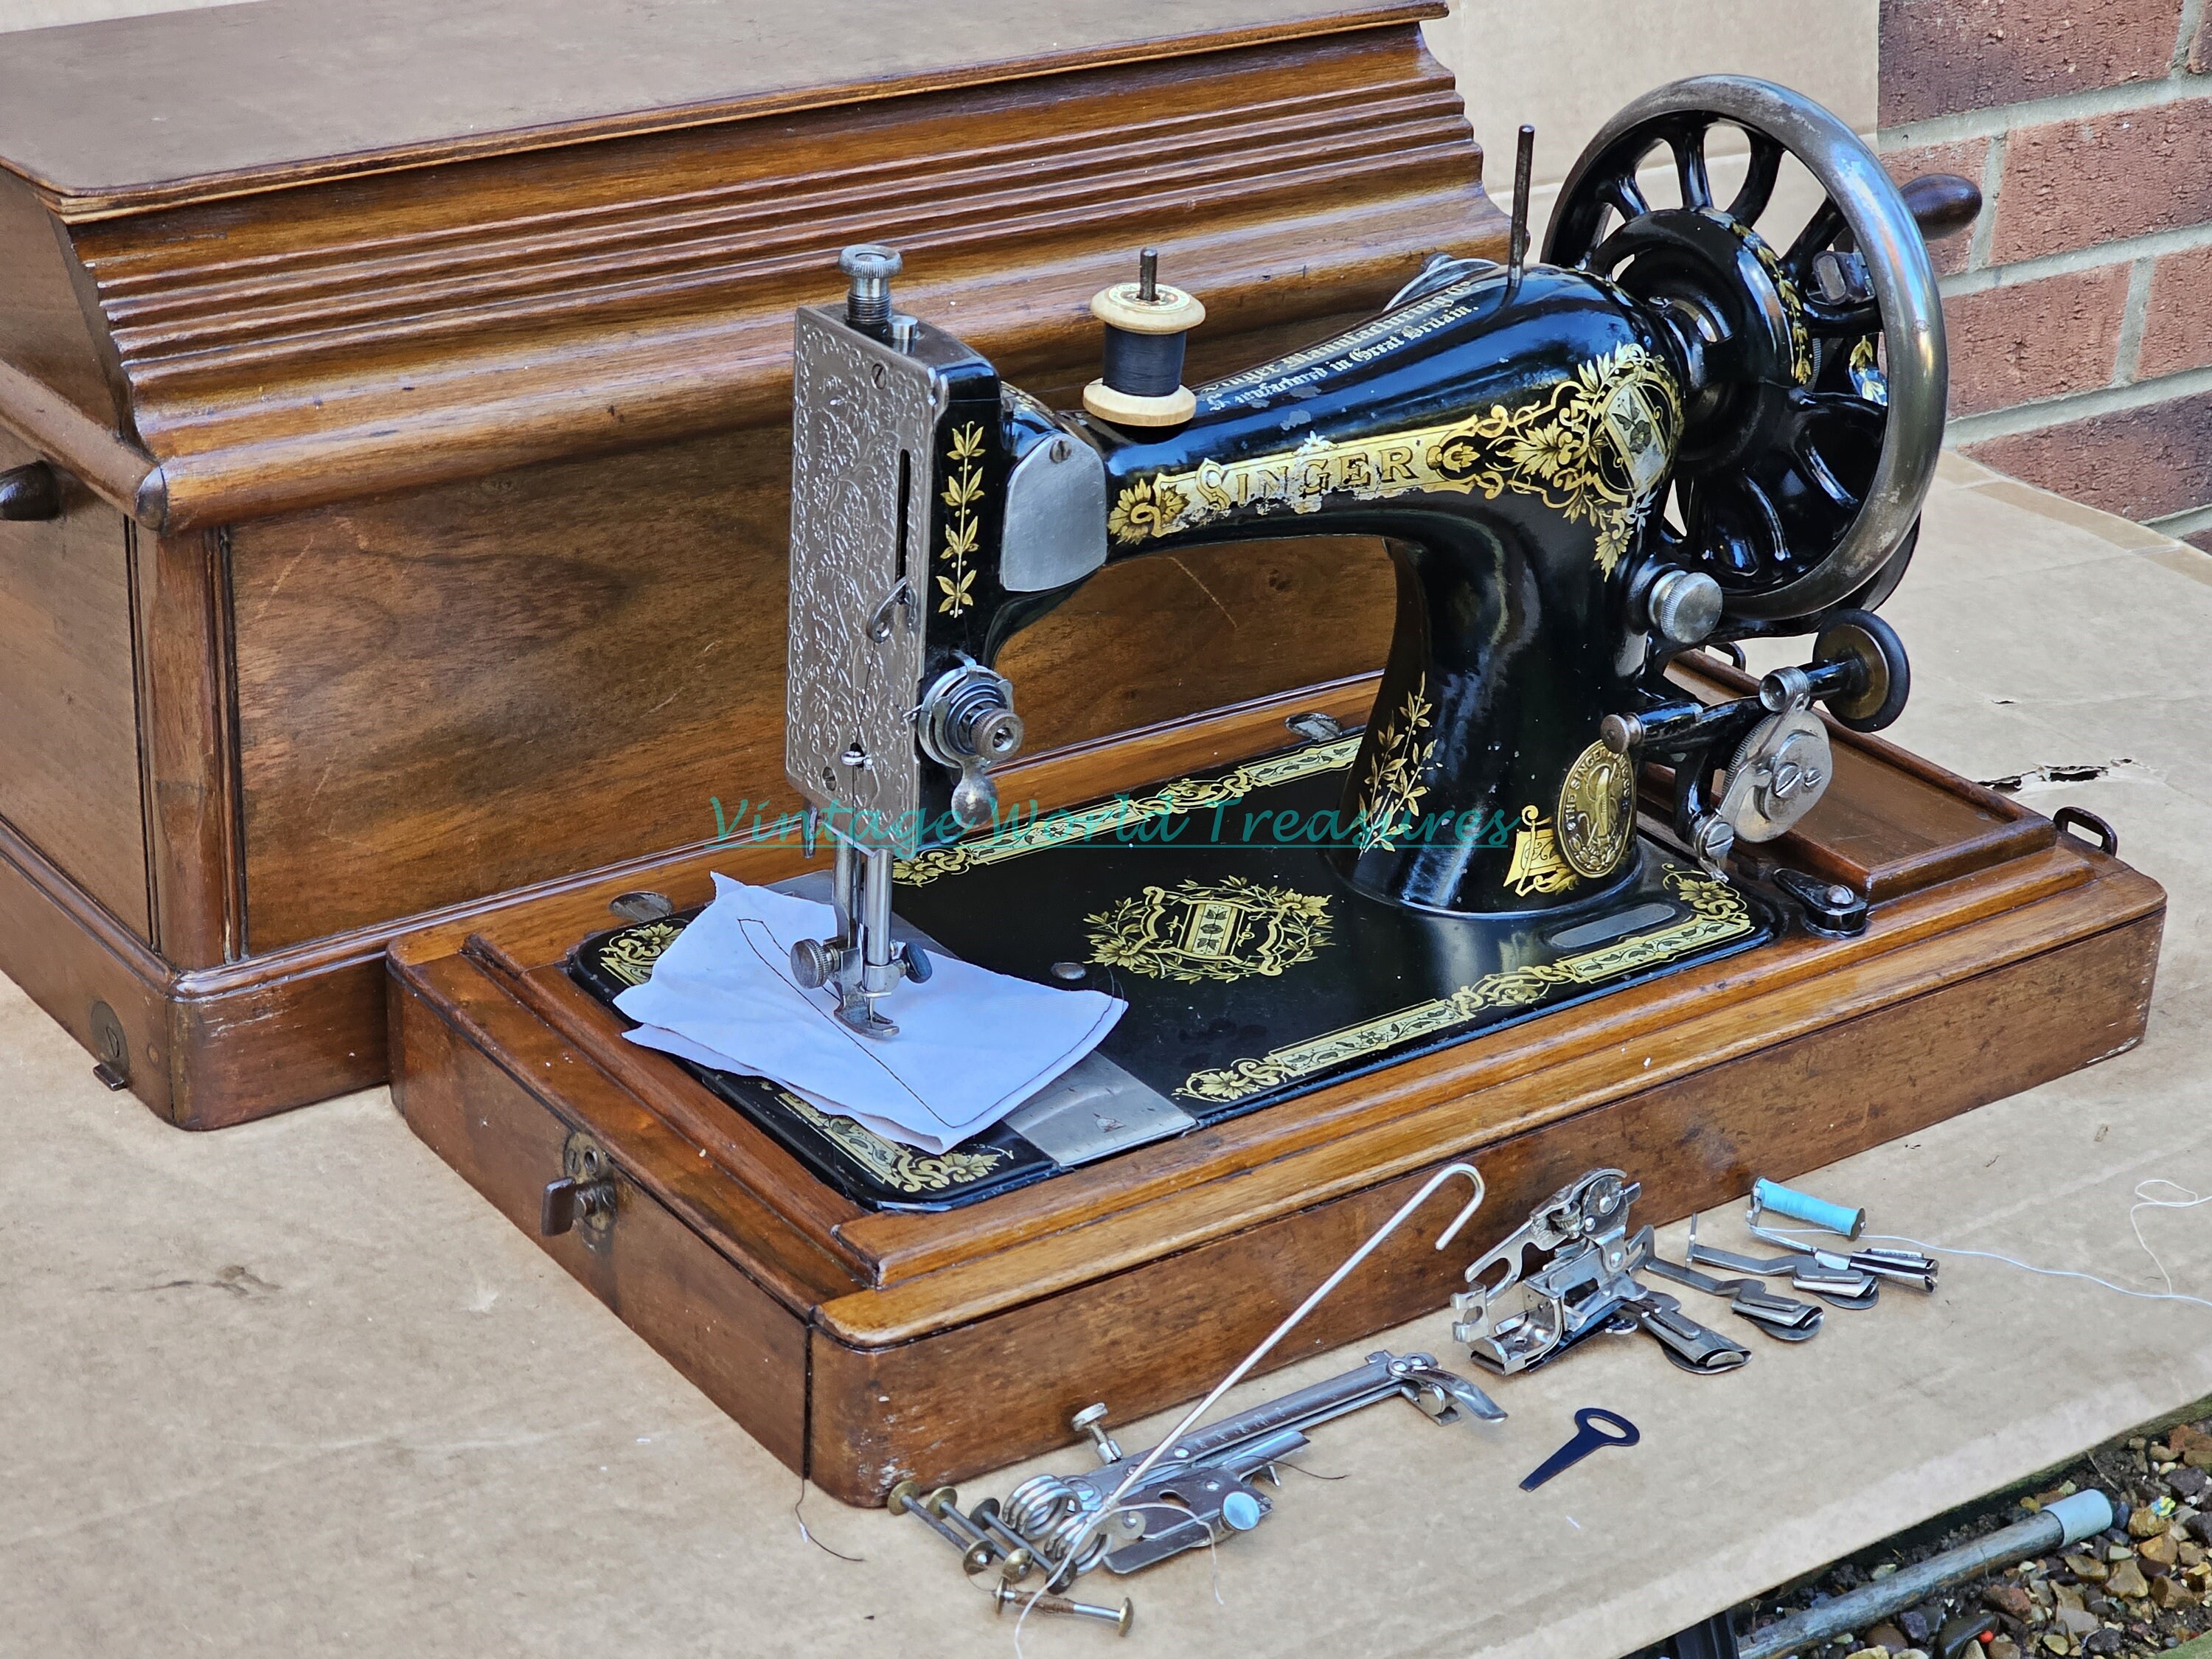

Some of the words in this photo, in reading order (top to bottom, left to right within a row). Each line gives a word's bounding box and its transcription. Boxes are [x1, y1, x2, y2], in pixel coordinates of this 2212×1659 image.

[1326, 359, 1353, 372] in
[1349, 335, 1405, 361] Great
[1195, 446, 1420, 511] SINGER
